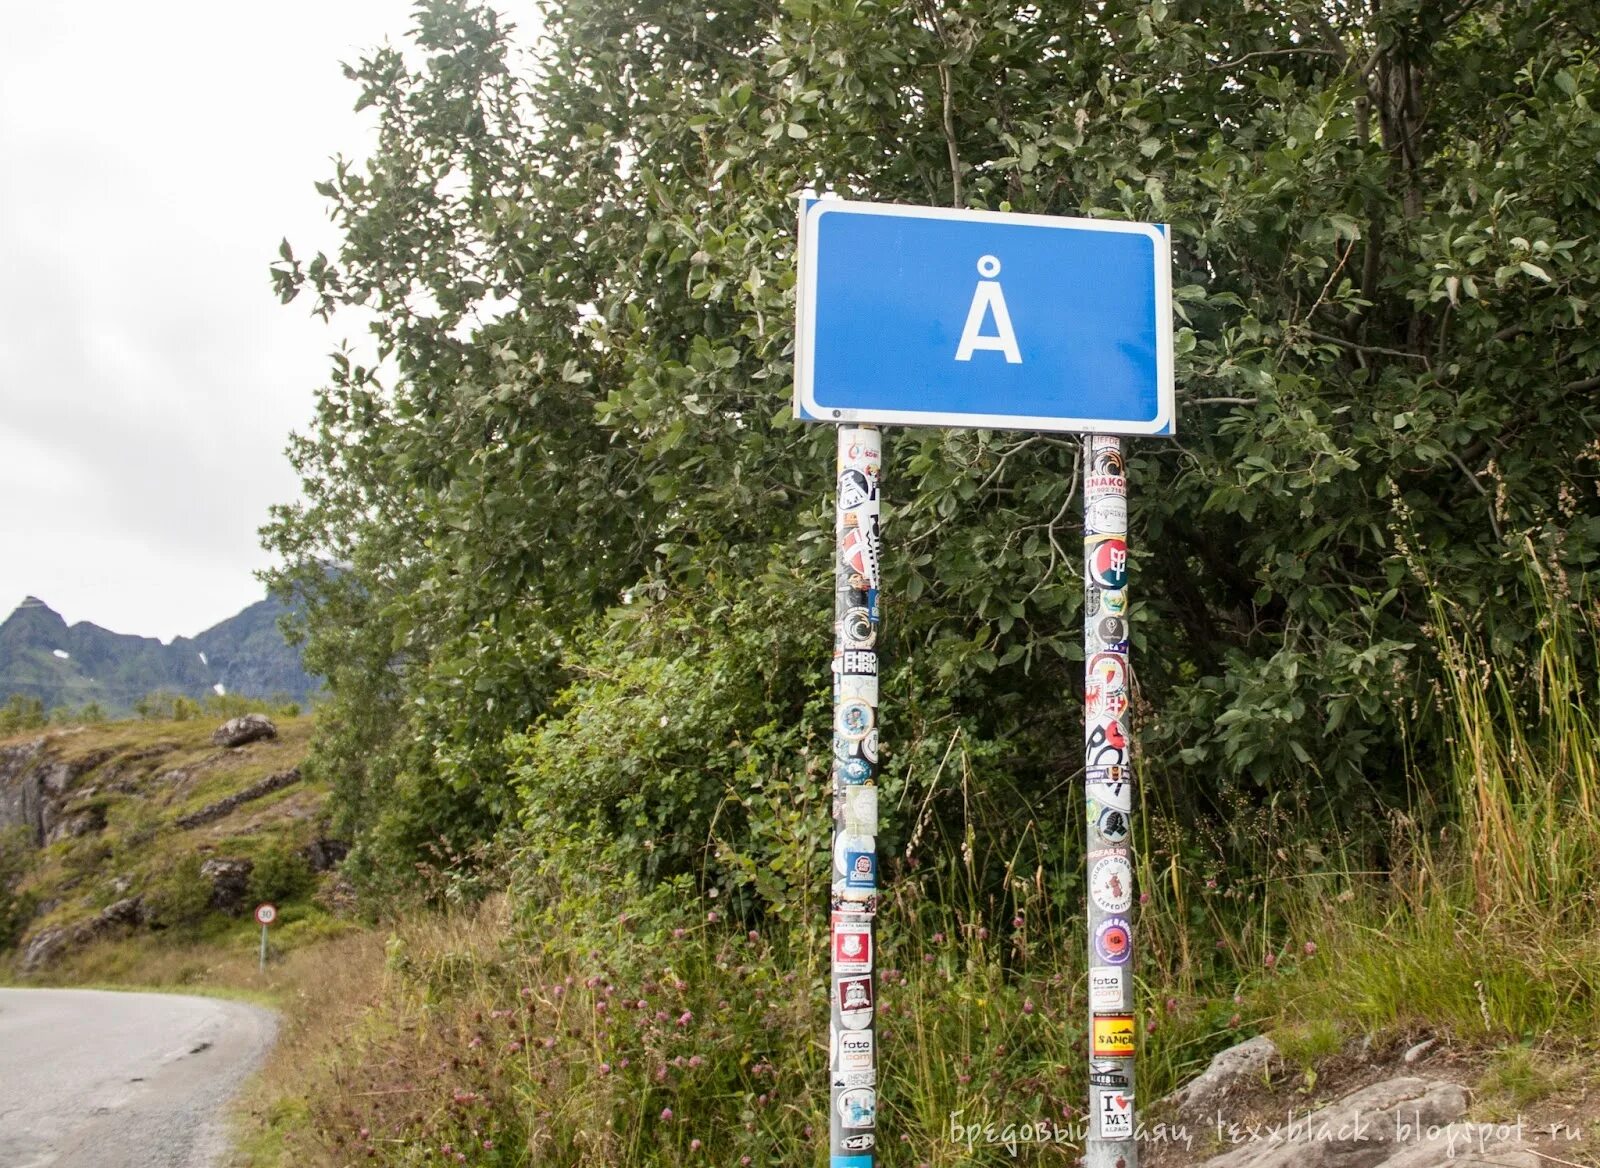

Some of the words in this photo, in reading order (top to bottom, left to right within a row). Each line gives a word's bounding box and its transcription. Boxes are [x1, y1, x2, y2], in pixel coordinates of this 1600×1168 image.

[954, 255, 1023, 364] Å
[1093, 977, 1119, 985] foto
[843, 1041, 870, 1049] foto
[1104, 1095, 1114, 1112] I
[1105, 1113, 1130, 1125] MY
